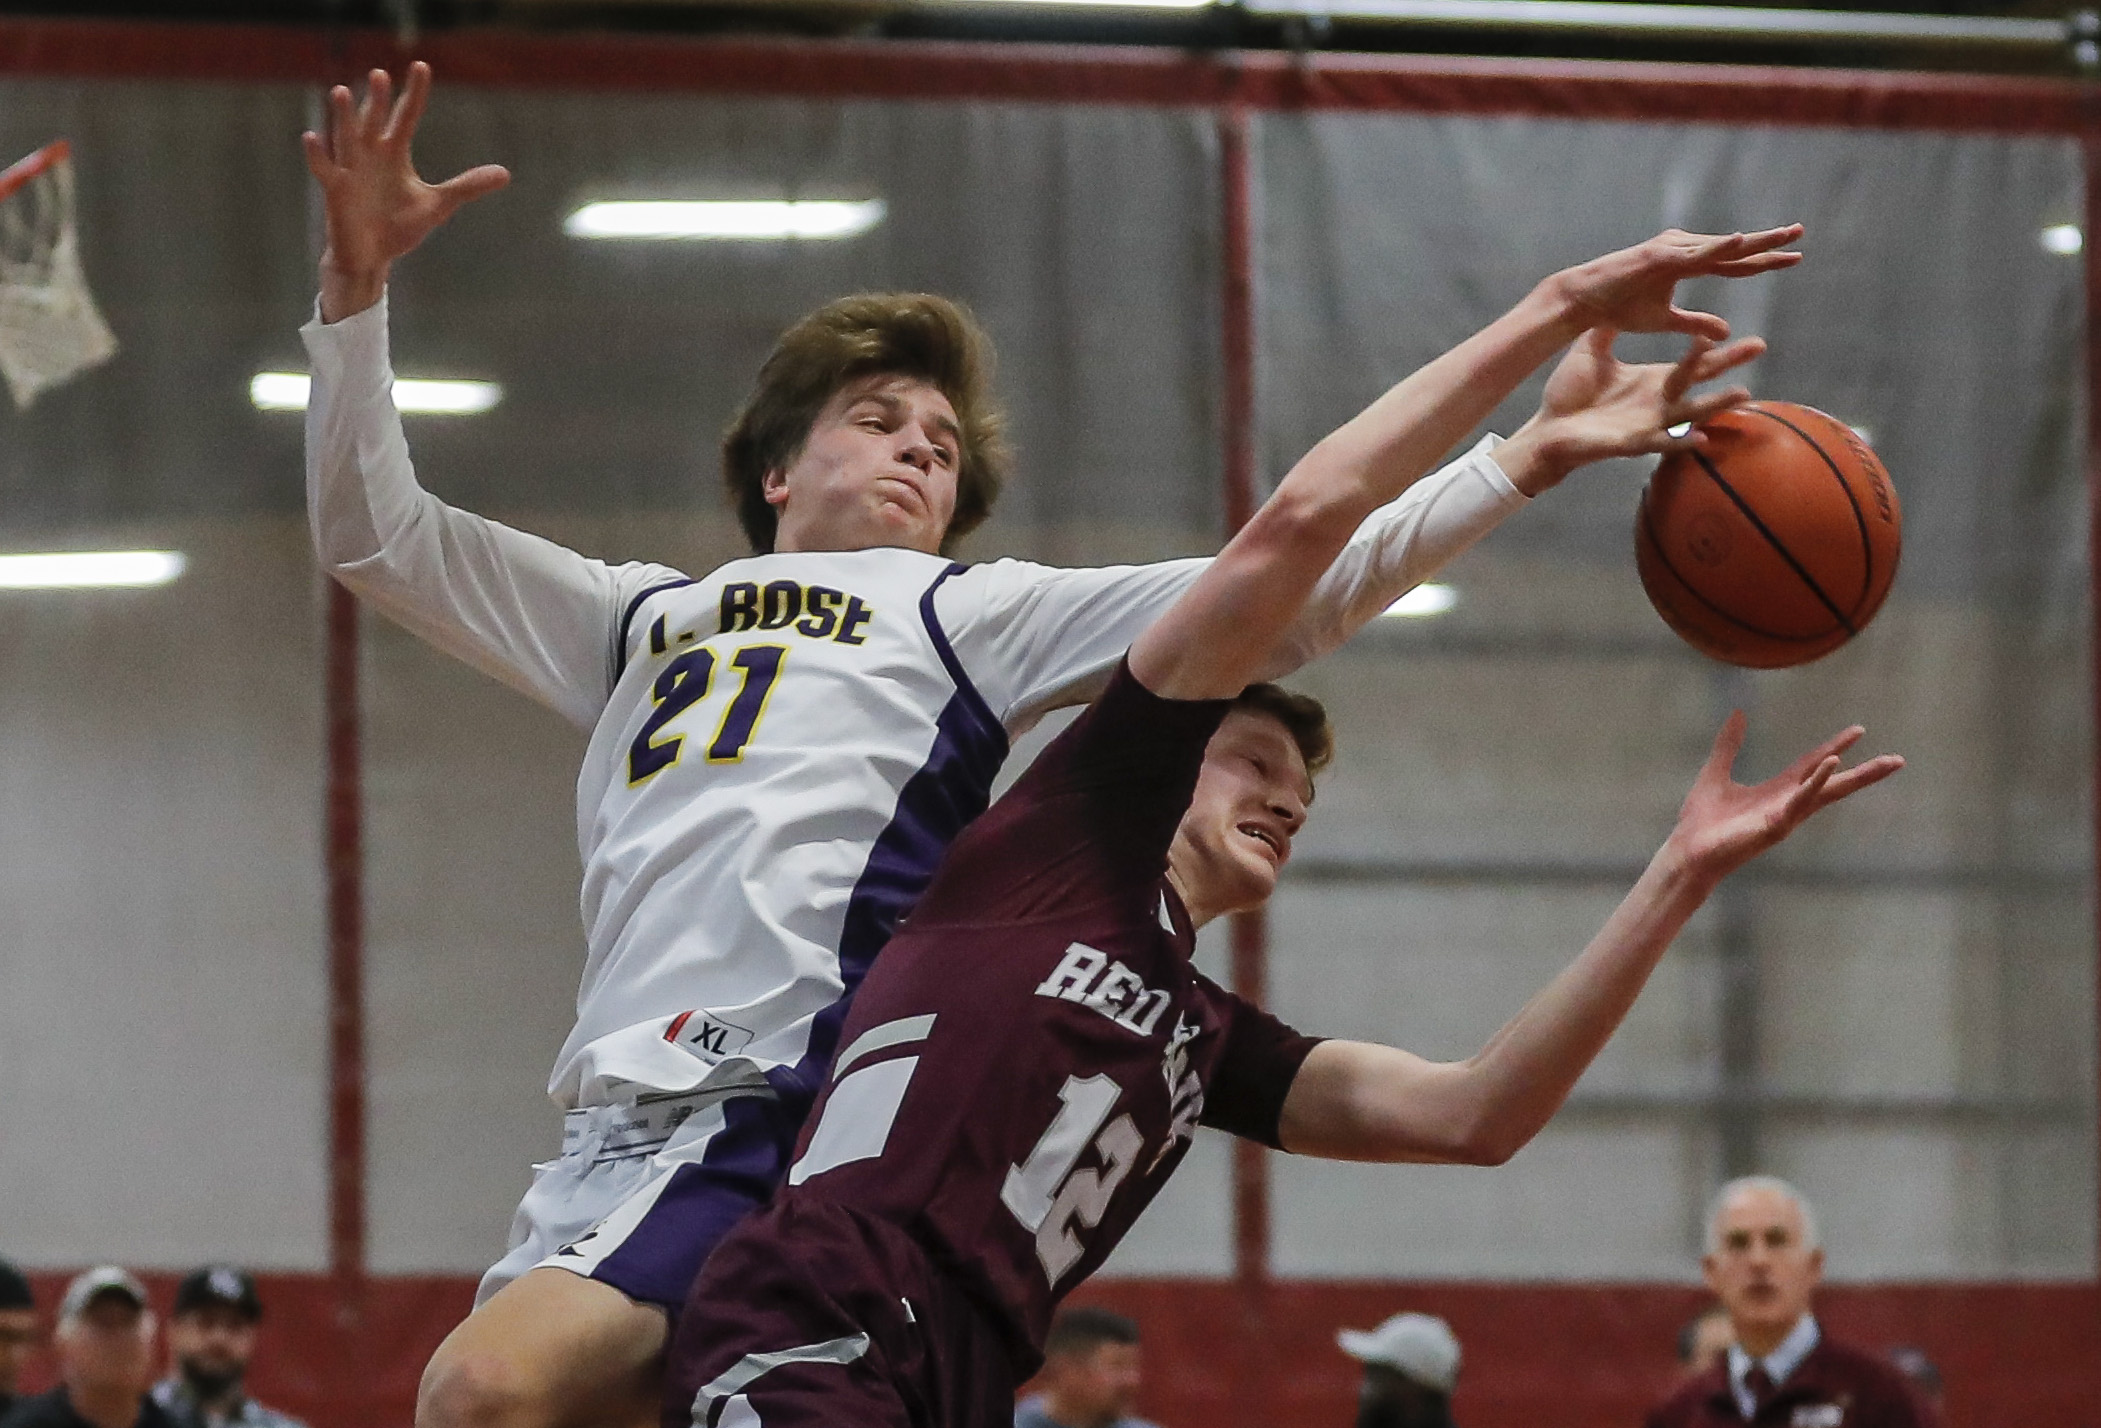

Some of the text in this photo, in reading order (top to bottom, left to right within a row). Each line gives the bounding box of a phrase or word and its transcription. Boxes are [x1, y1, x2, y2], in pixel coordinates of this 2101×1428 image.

[627, 643, 791, 789] 21
[690, 1021, 729, 1056] XL
[1000, 1072, 1145, 1291] 12
